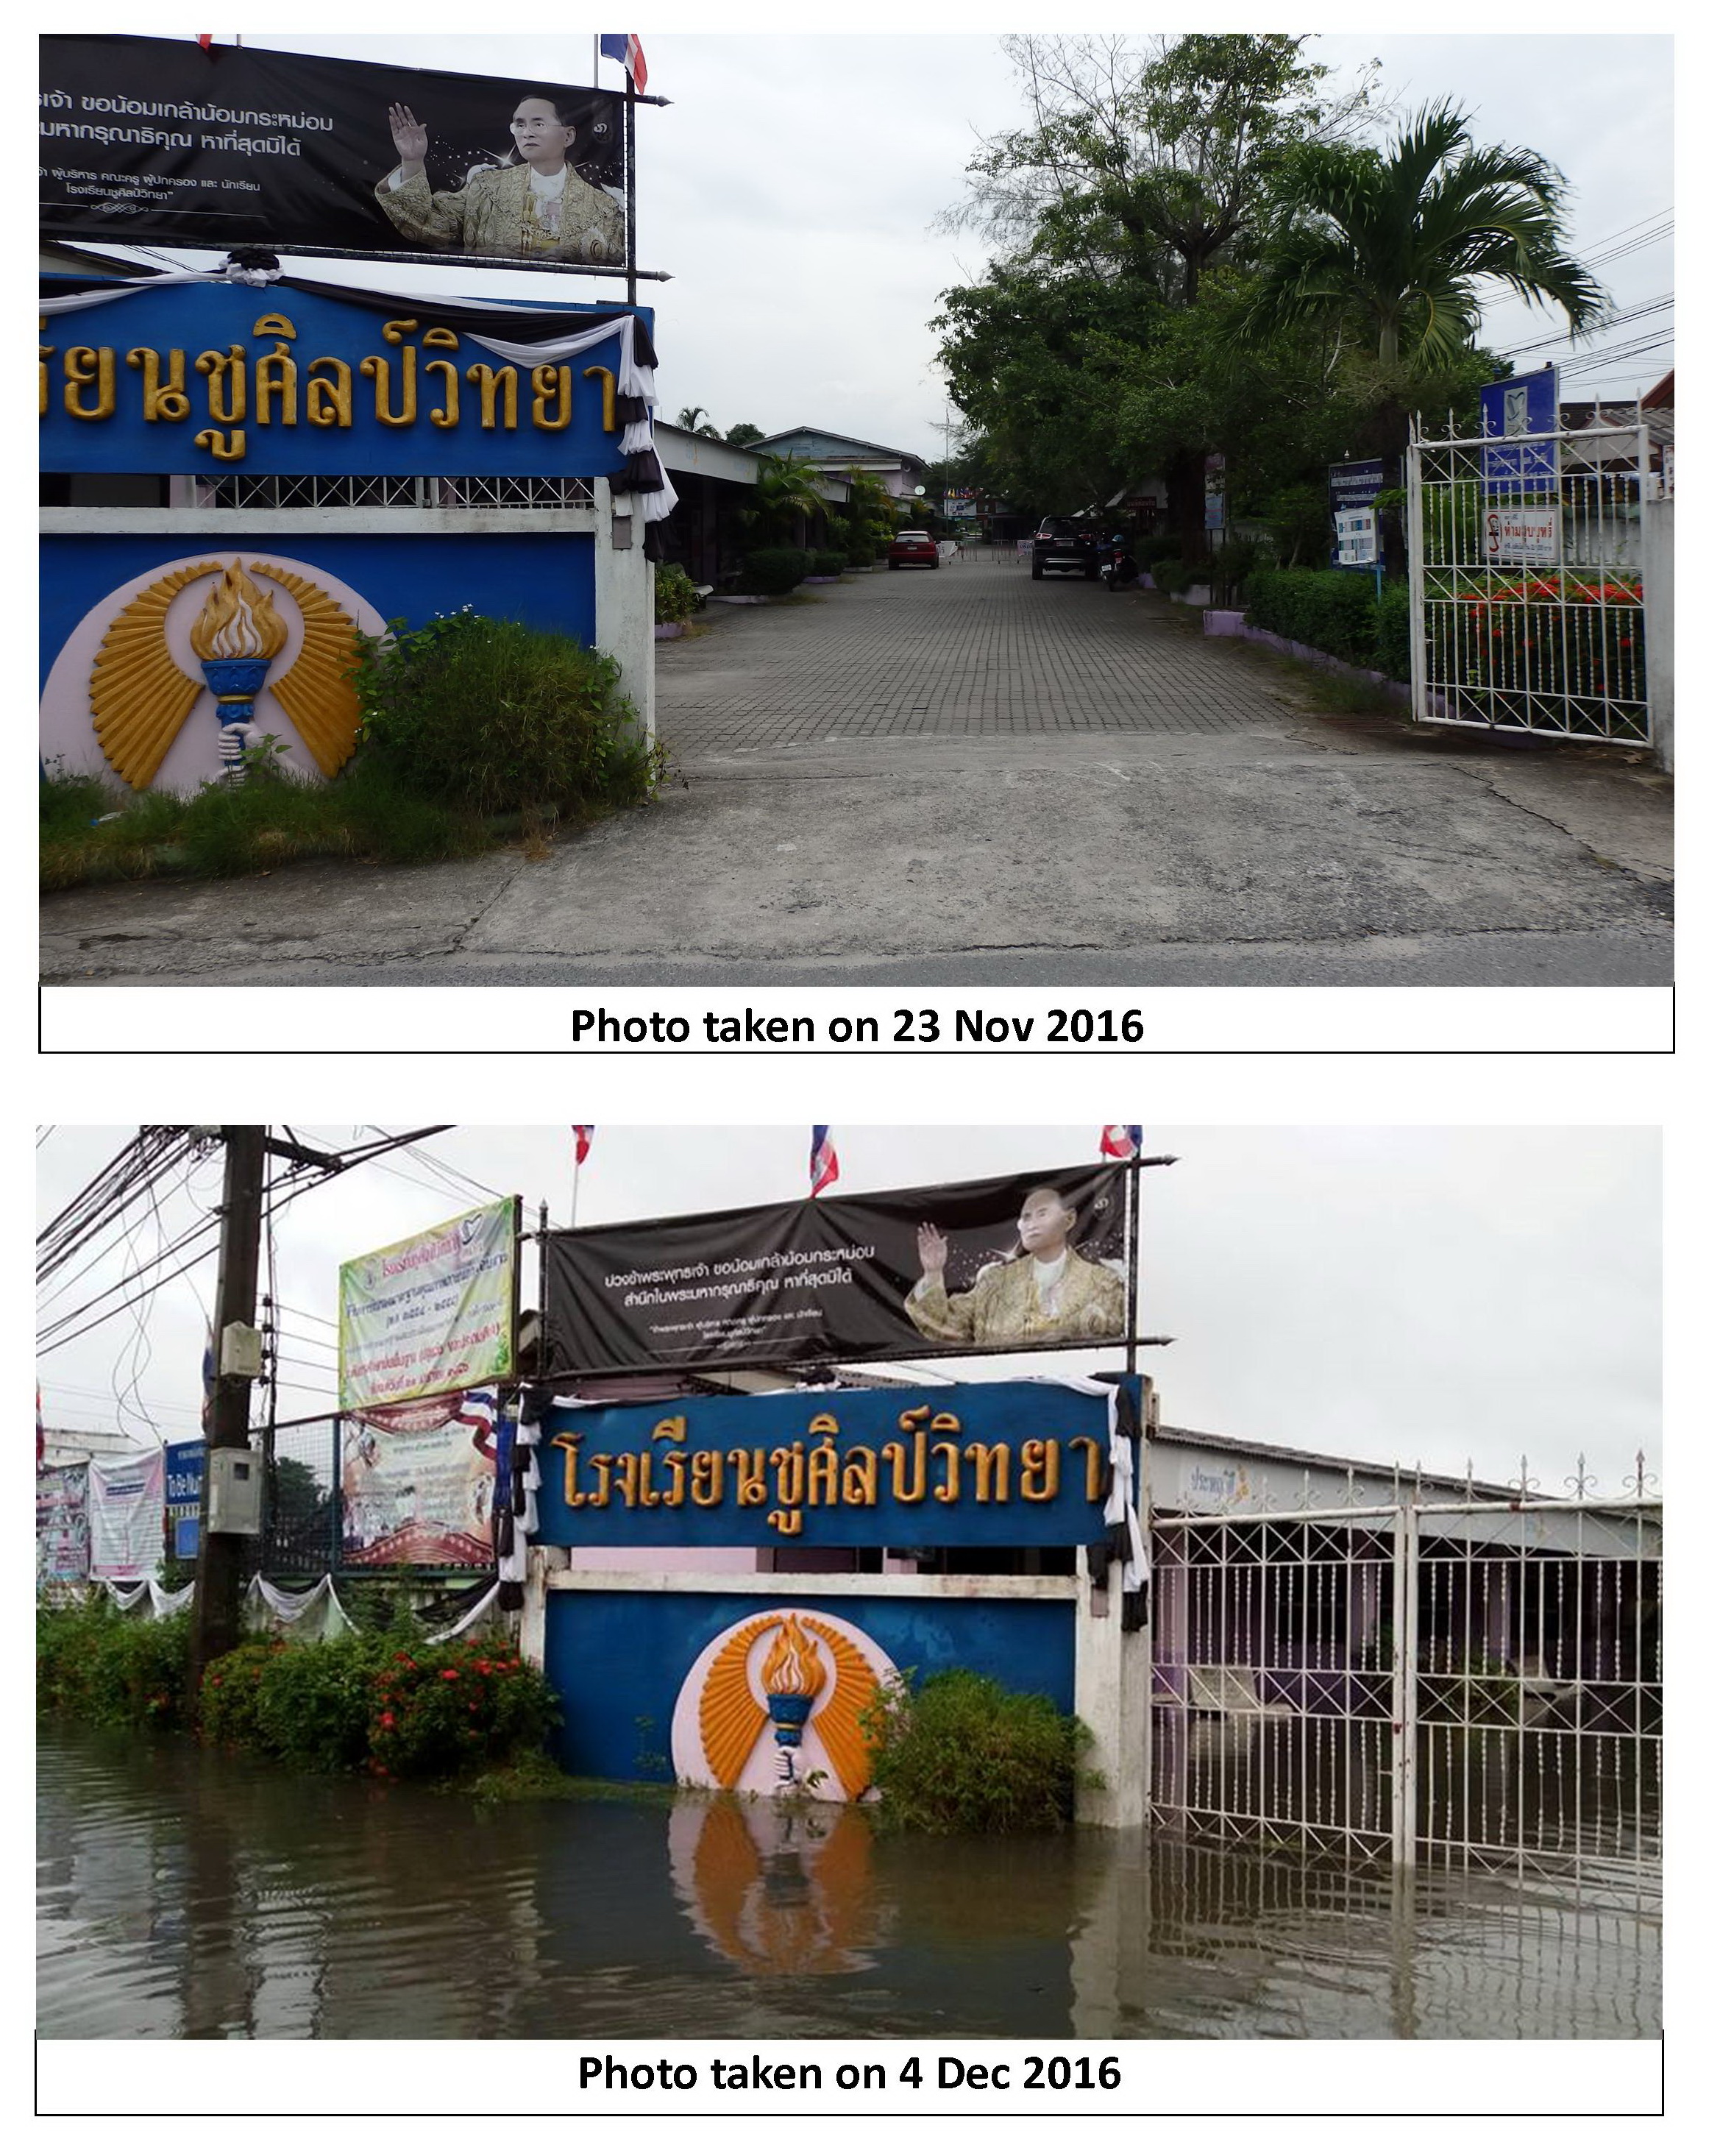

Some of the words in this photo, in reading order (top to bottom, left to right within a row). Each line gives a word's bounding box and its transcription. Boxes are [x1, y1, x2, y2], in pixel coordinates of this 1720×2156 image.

[39, 88, 73, 110] เจ้า
[81, 95, 333, 132] ขอน้อมเกล้าน้อมกระหม่อม
[39, 121, 192, 150] มหากรุณาธิคุณ
[201, 130, 302, 157] หาที่สุดมิได้
[102, 173, 140, 185] คณะครู
[201, 180, 218, 188] และ
[221, 179, 260, 191] นักเรียน
[714, 1244, 875, 1277] ขอน้อมเกล้าน้อมกระหม่อม
[550, 1404, 1105, 1537] โรงเรียนชูศิลป์วิทยา
